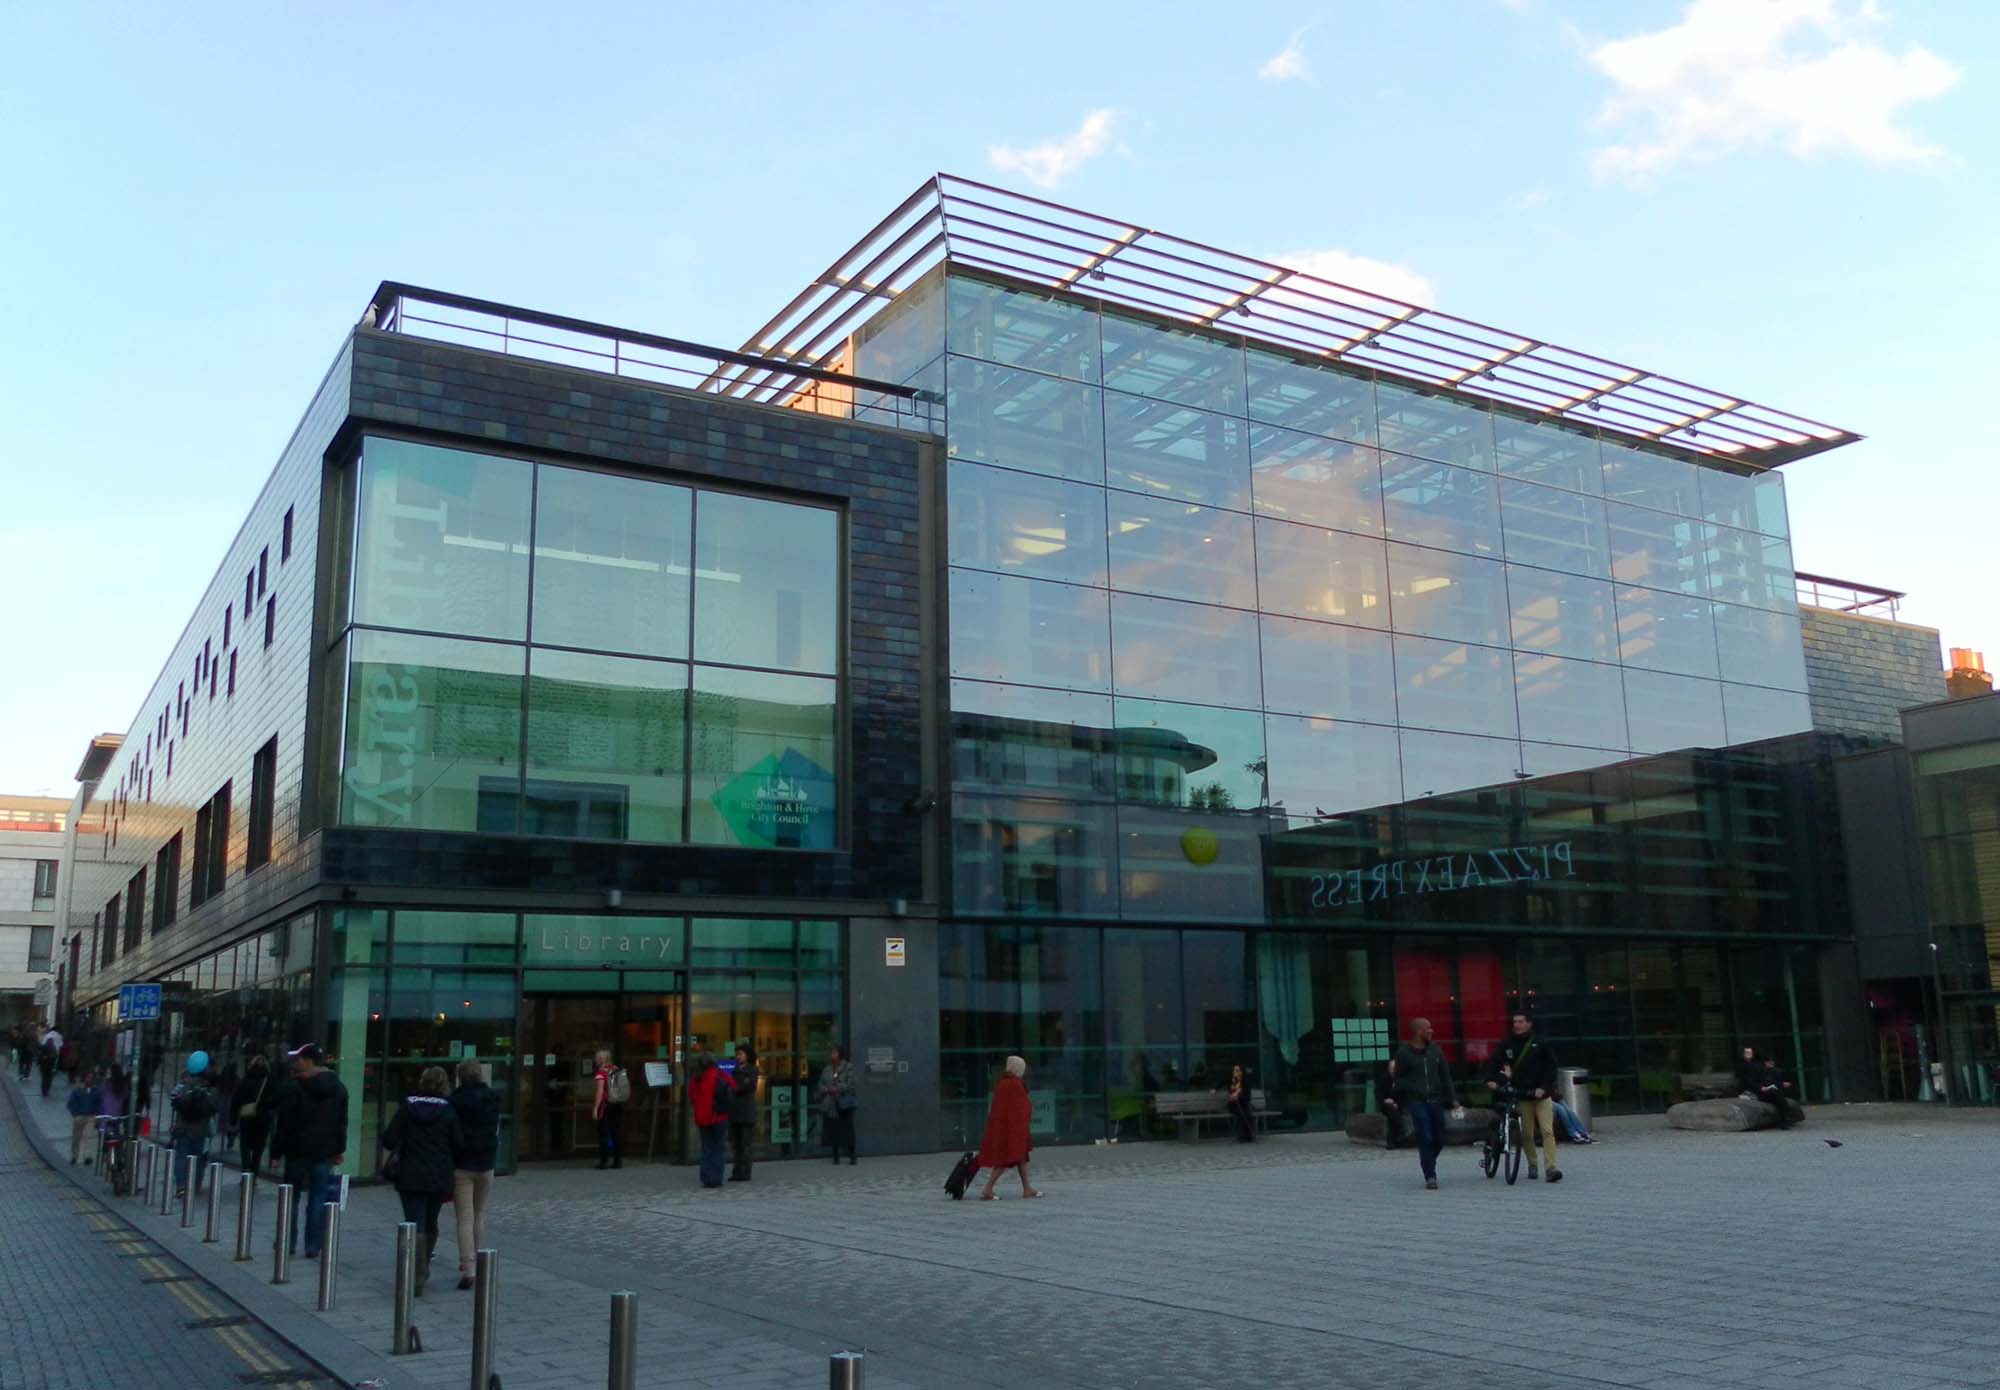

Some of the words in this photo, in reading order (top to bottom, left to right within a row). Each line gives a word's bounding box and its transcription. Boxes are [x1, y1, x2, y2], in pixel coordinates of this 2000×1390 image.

[346, 487, 448, 825] Library
[784, 803, 793, 812] &
[773, 814, 809, 824] Council
[541, 927, 672, 958] Library
